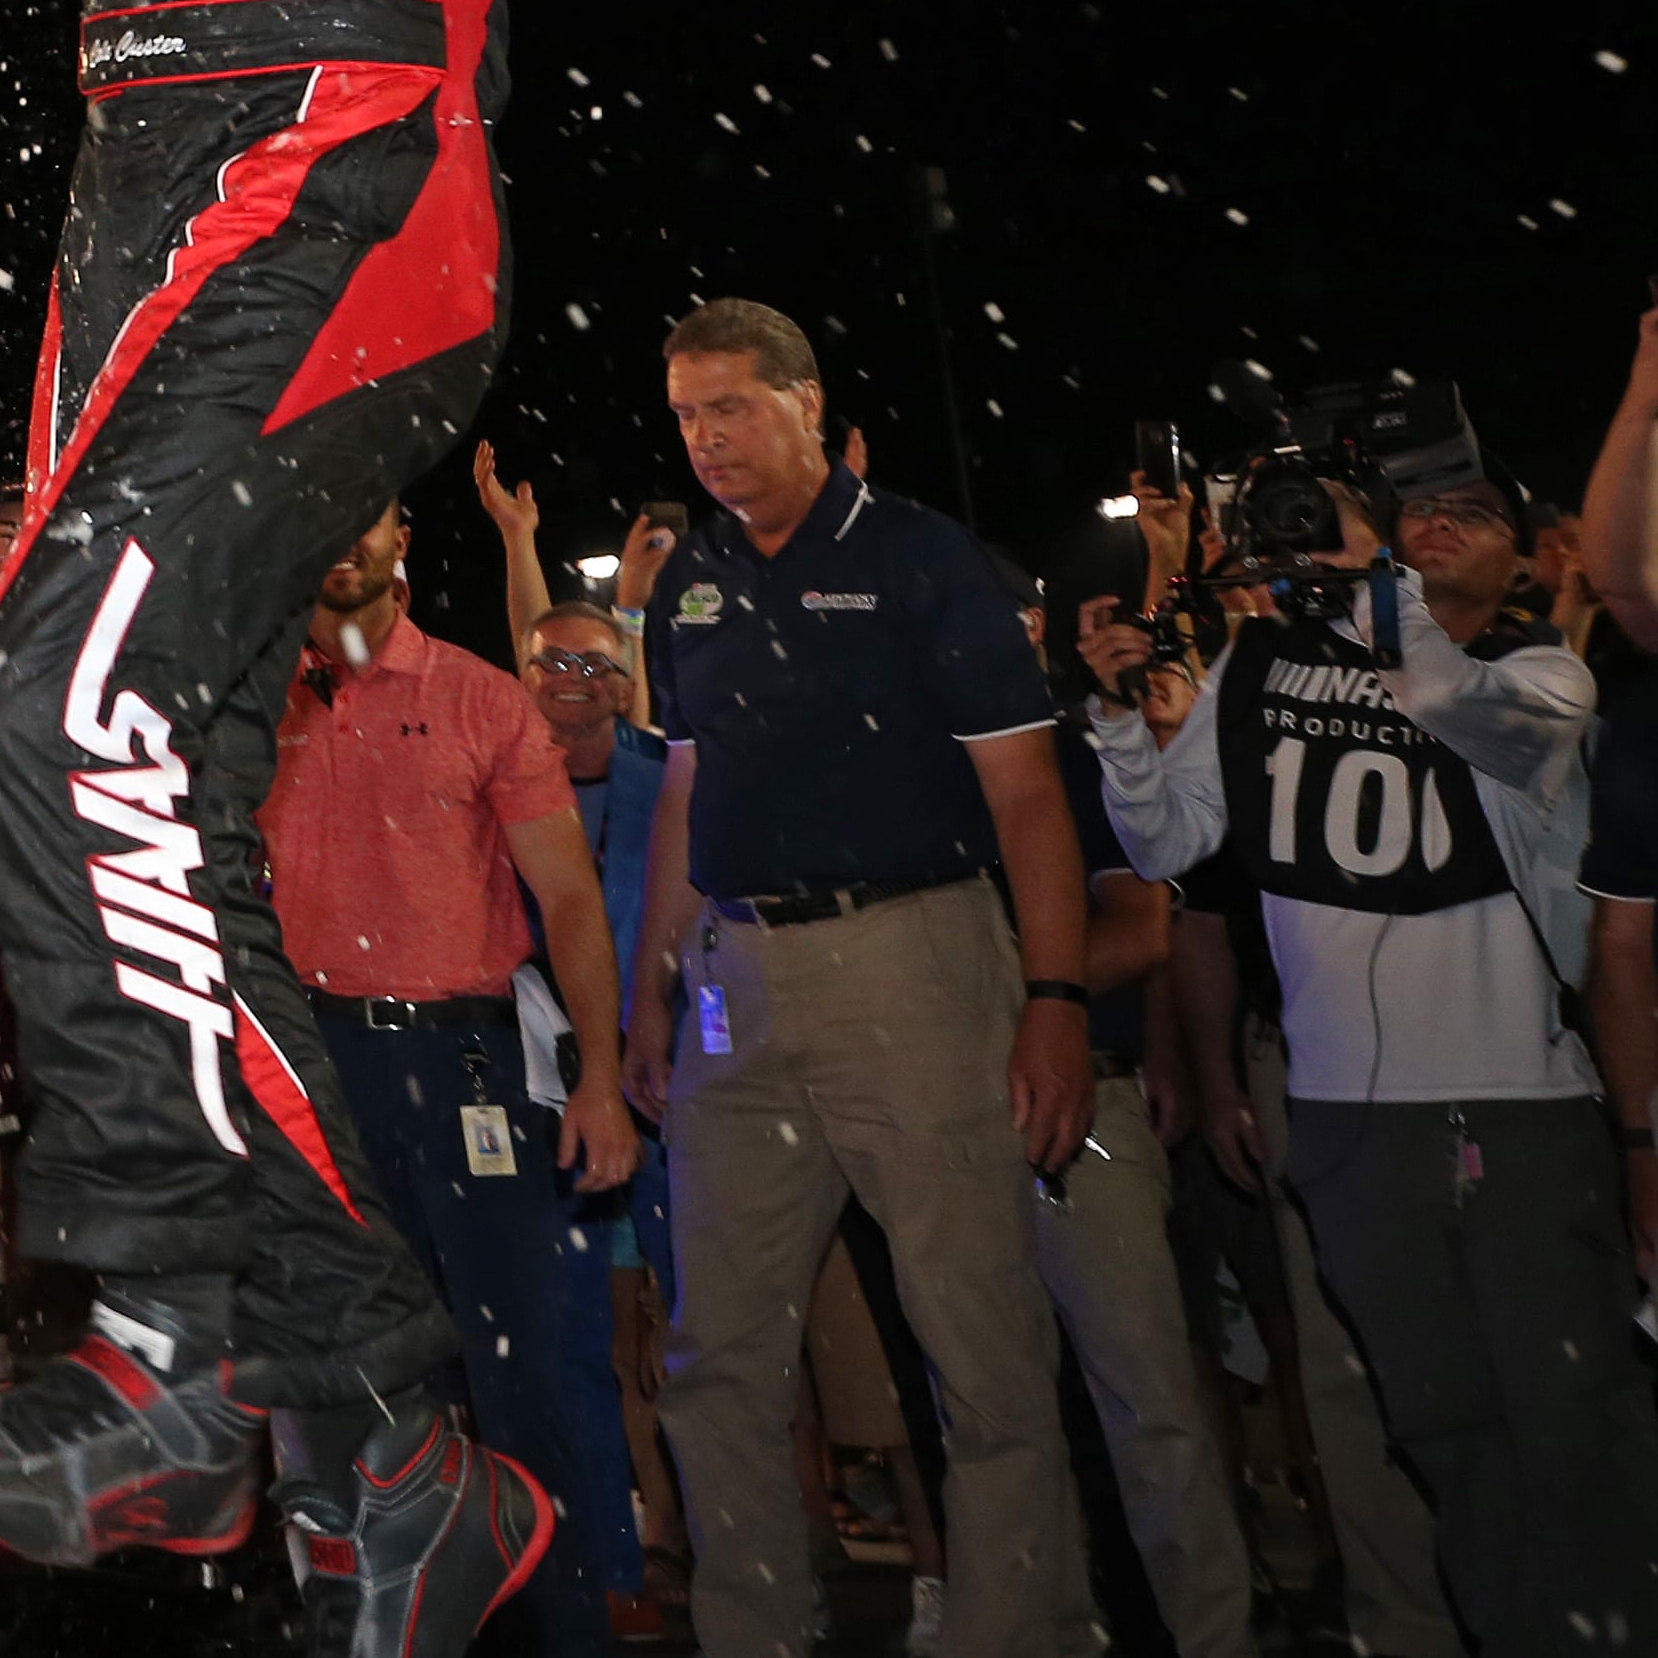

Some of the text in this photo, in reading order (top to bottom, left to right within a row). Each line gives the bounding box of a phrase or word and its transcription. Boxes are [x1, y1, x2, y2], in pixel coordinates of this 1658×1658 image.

[115, 30, 186, 62] Custer
[1262, 708, 1436, 744] PRODUCTI
[64, 534, 250, 1160] HAAS
